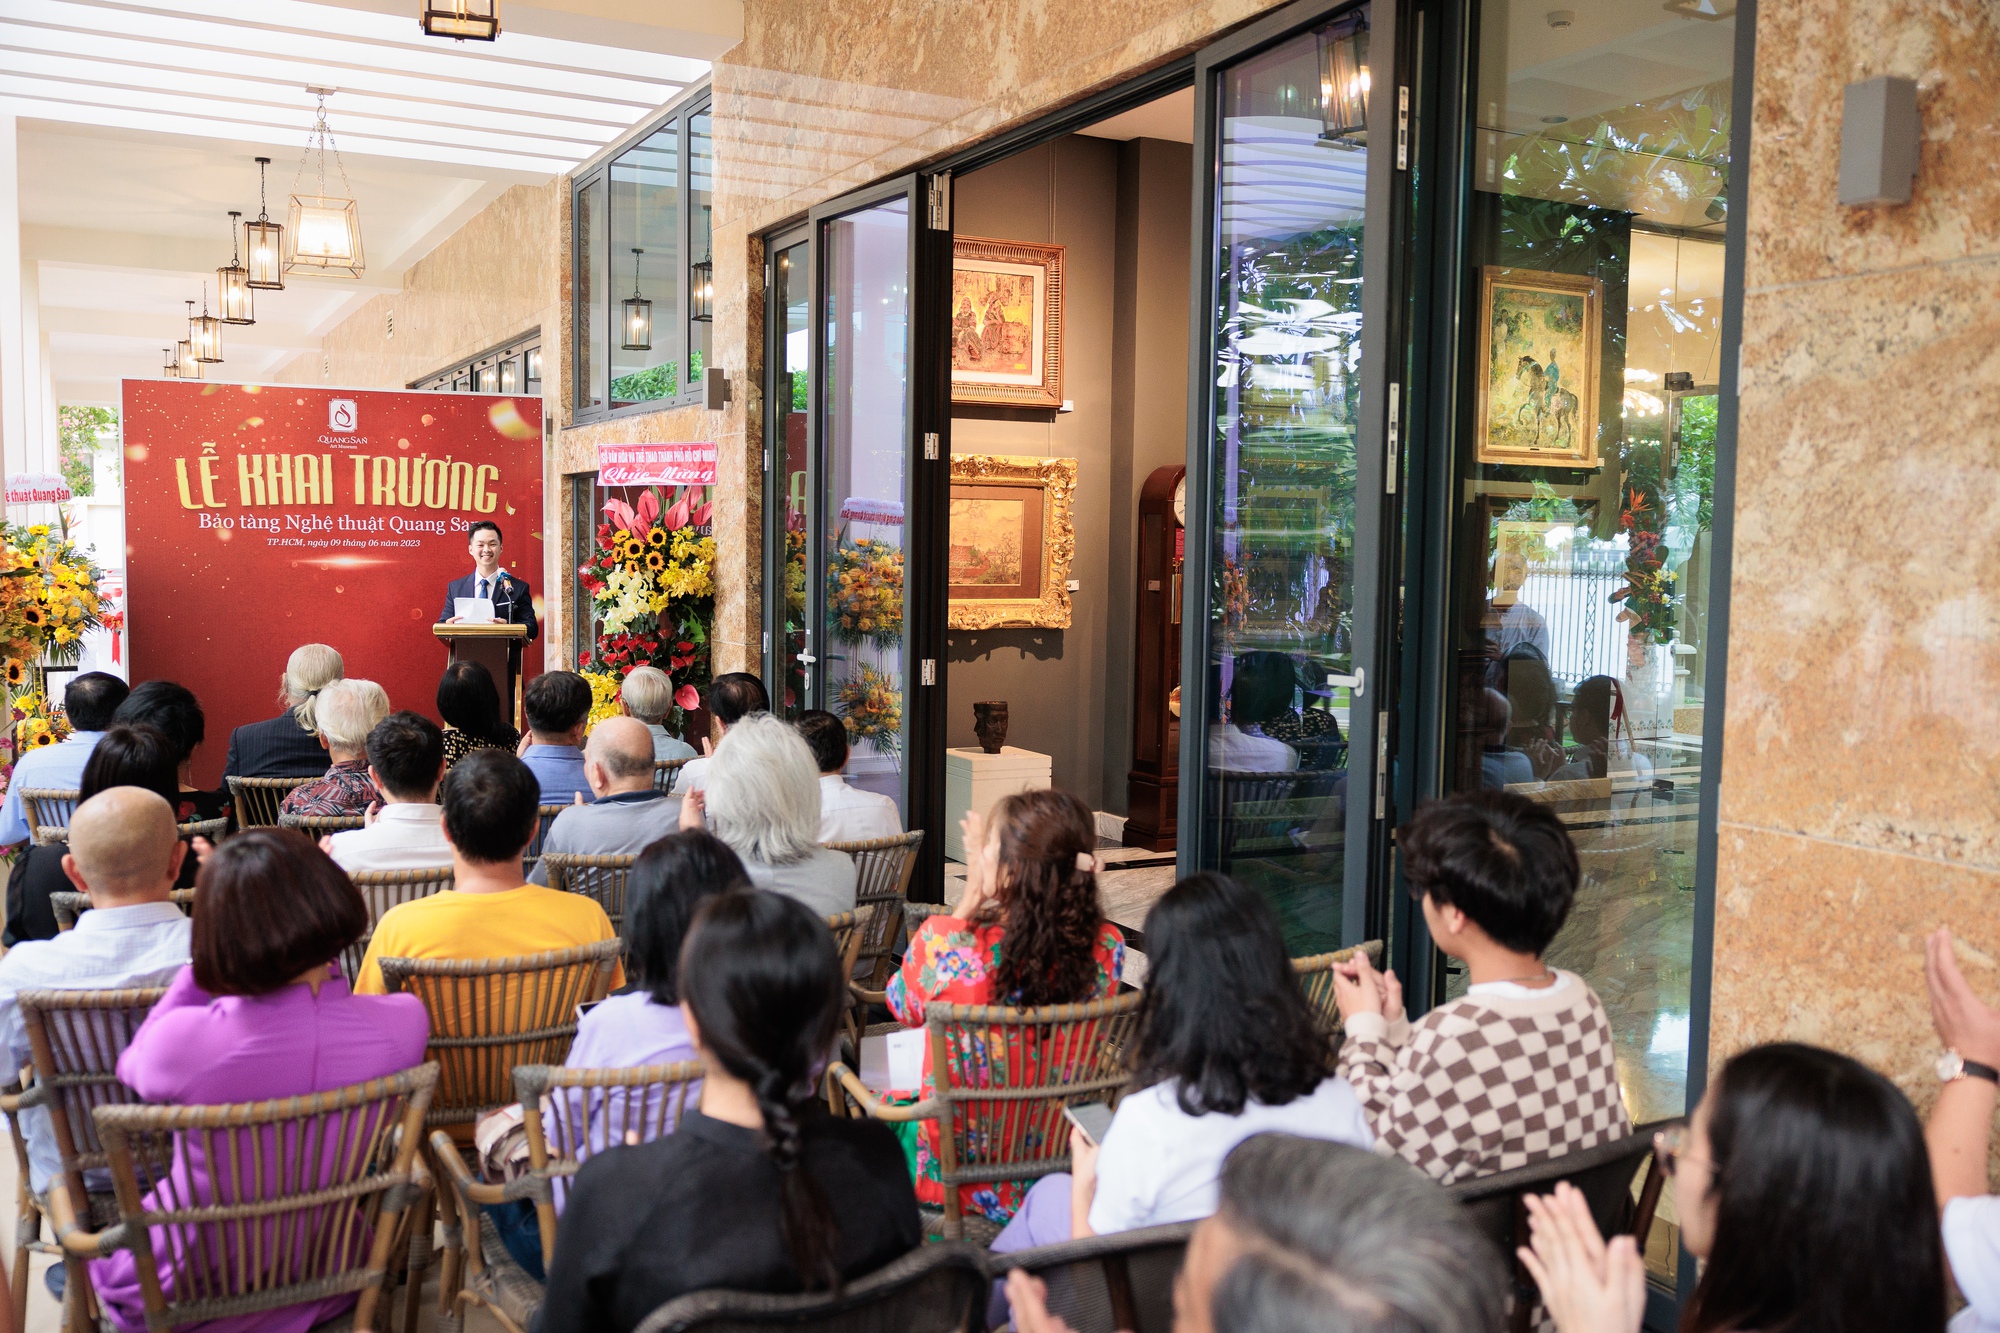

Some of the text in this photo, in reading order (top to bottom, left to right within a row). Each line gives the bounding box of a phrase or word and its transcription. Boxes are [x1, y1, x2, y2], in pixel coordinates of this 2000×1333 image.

[175, 441, 499, 514] LỄ KHAI TRƯƠNG
[604, 467, 714, 482] Chúc Mừng
[33, 488, 56, 503] Quang
[57, 487, 70, 501] San
[198, 512, 235, 529] Bảo
[239, 513, 281, 533] tàng
[285, 514, 333, 534] Nghệ
[337, 514, 384, 534] thuật
[389, 515, 447, 535] Quang
[267, 538, 421, 548] TP.HCM, ngày 09 tháng 06 năm 2023
